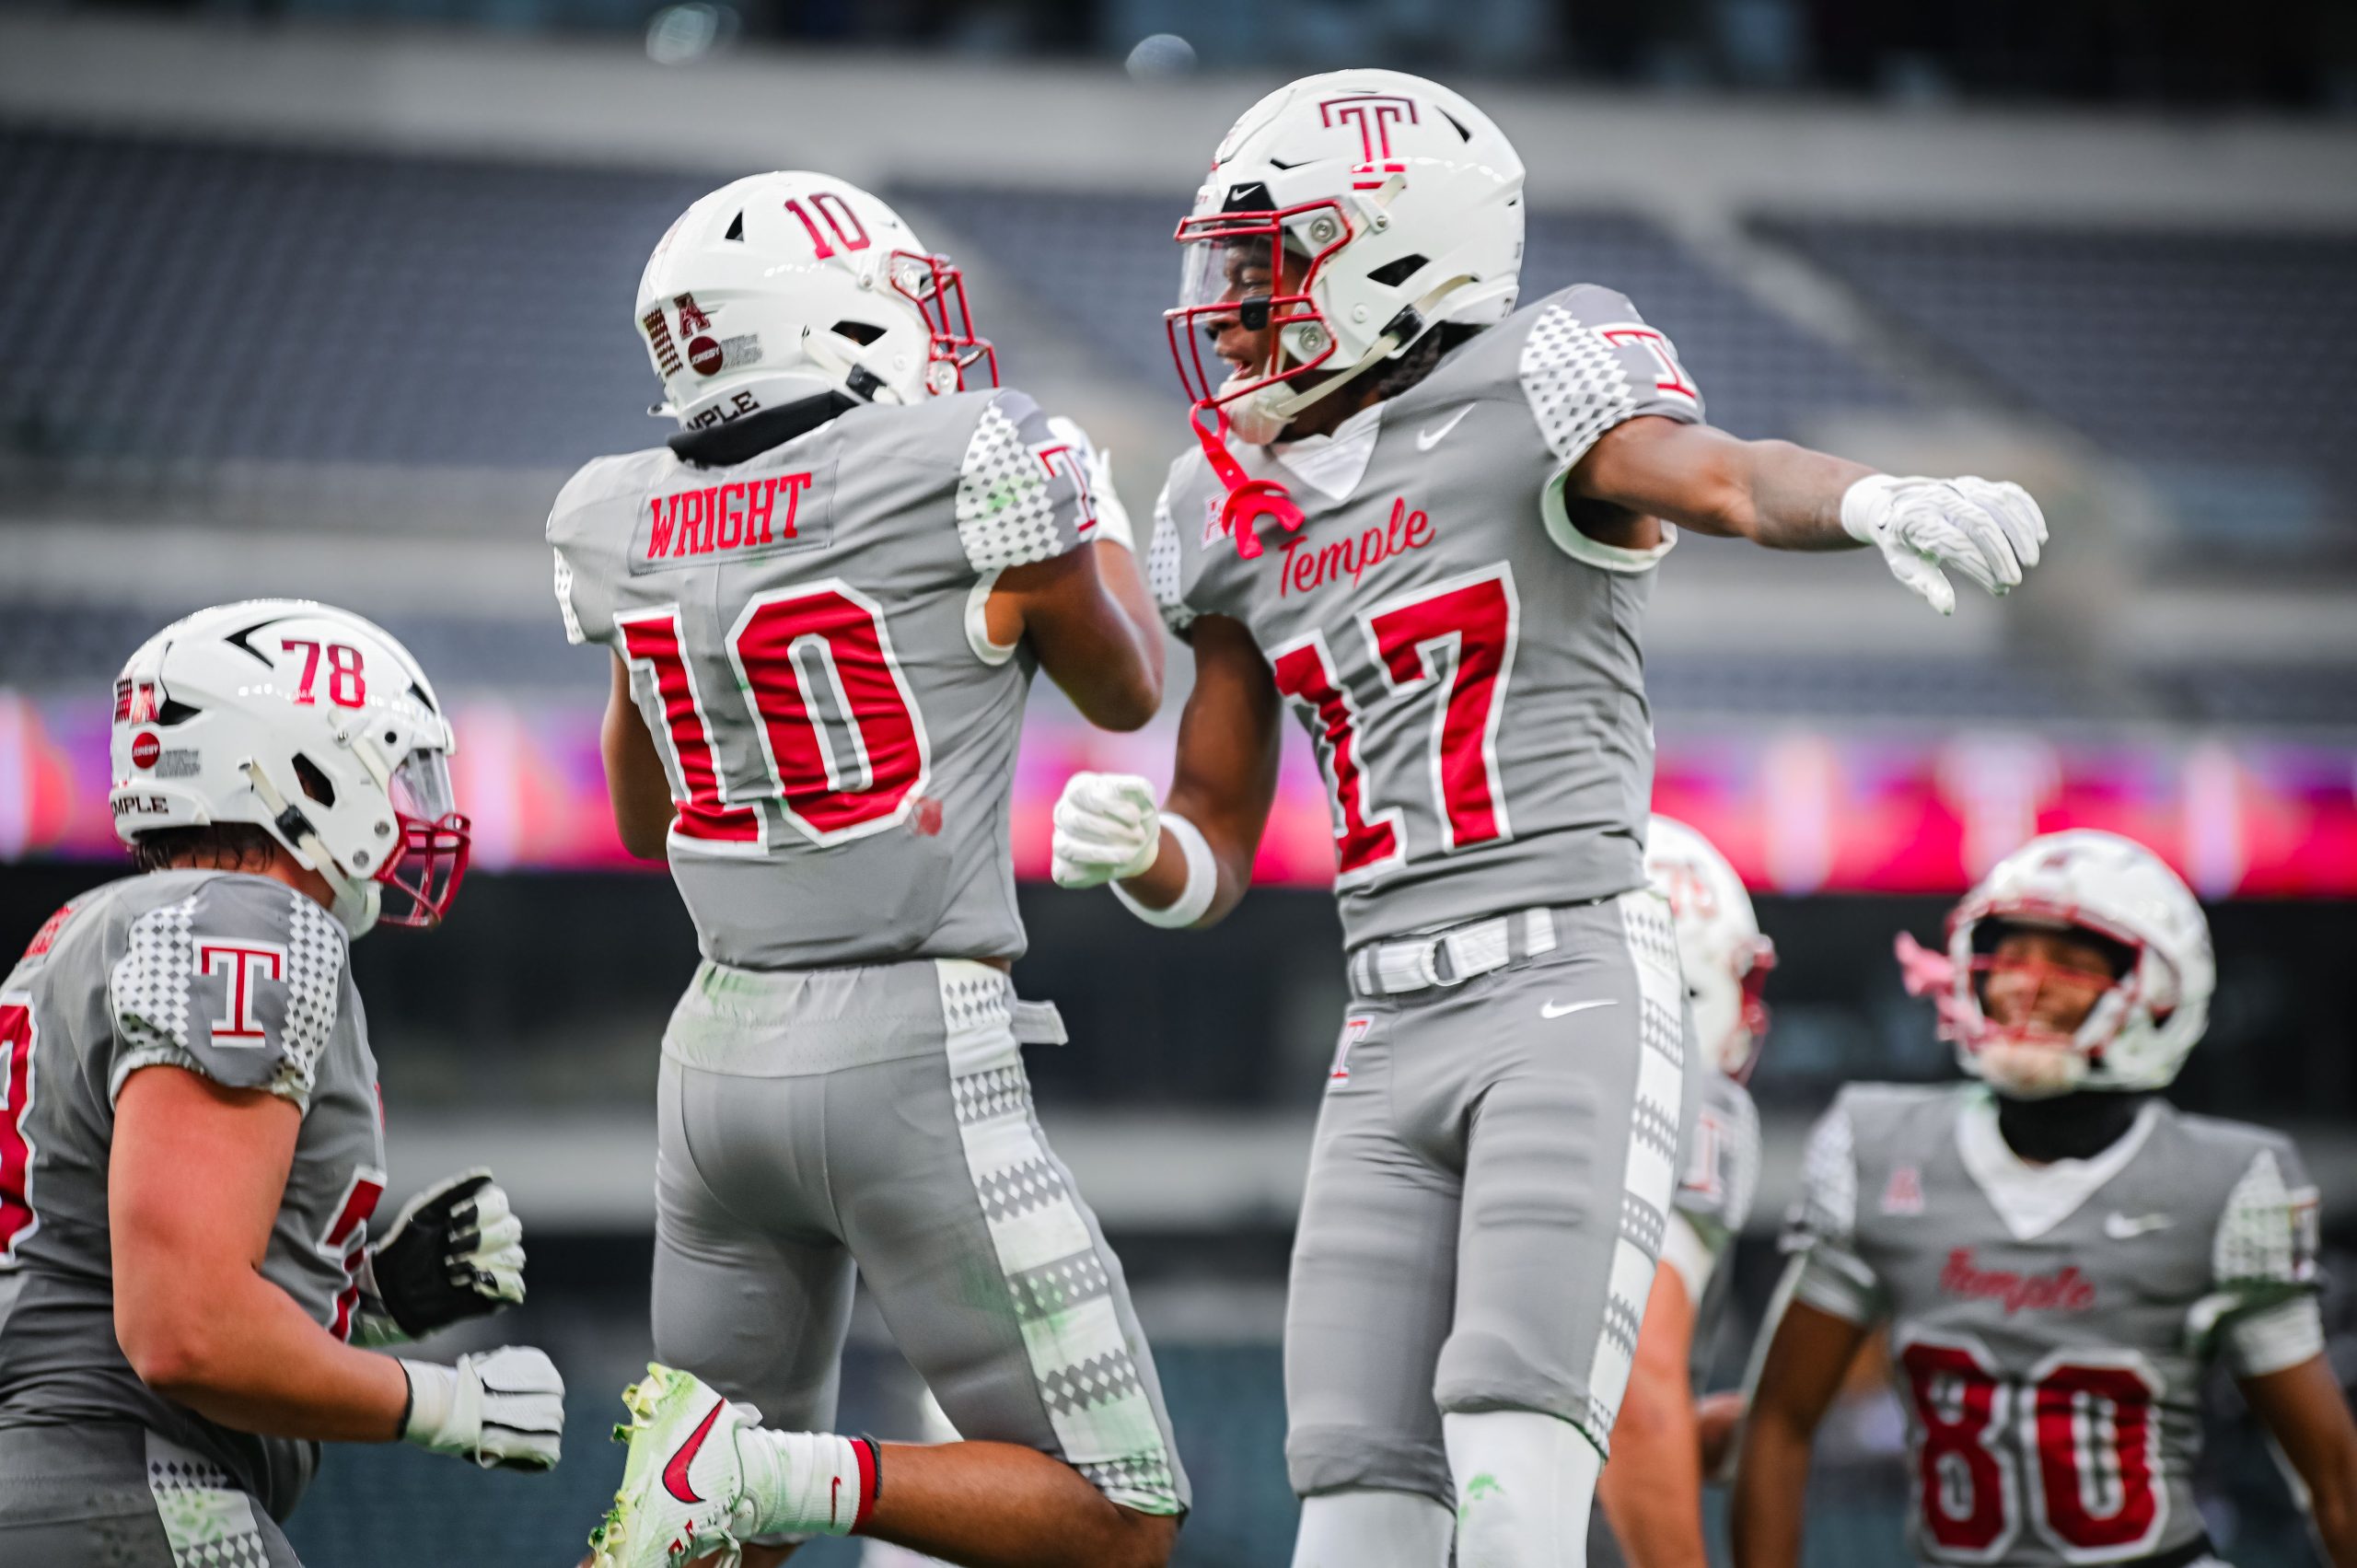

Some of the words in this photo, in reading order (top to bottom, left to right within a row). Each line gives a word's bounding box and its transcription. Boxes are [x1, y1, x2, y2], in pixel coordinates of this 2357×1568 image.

[1319, 95, 1420, 190] T
[784, 191, 871, 260] 10
[646, 471, 813, 560] WRIGHT
[1278, 497, 1437, 598] Temple
[281, 639, 366, 709] 78
[612, 577, 932, 857] 10
[1265, 560, 1521, 892] 17
[192, 937, 287, 1048] T
[1897, 1323, 2168, 1563] 80
